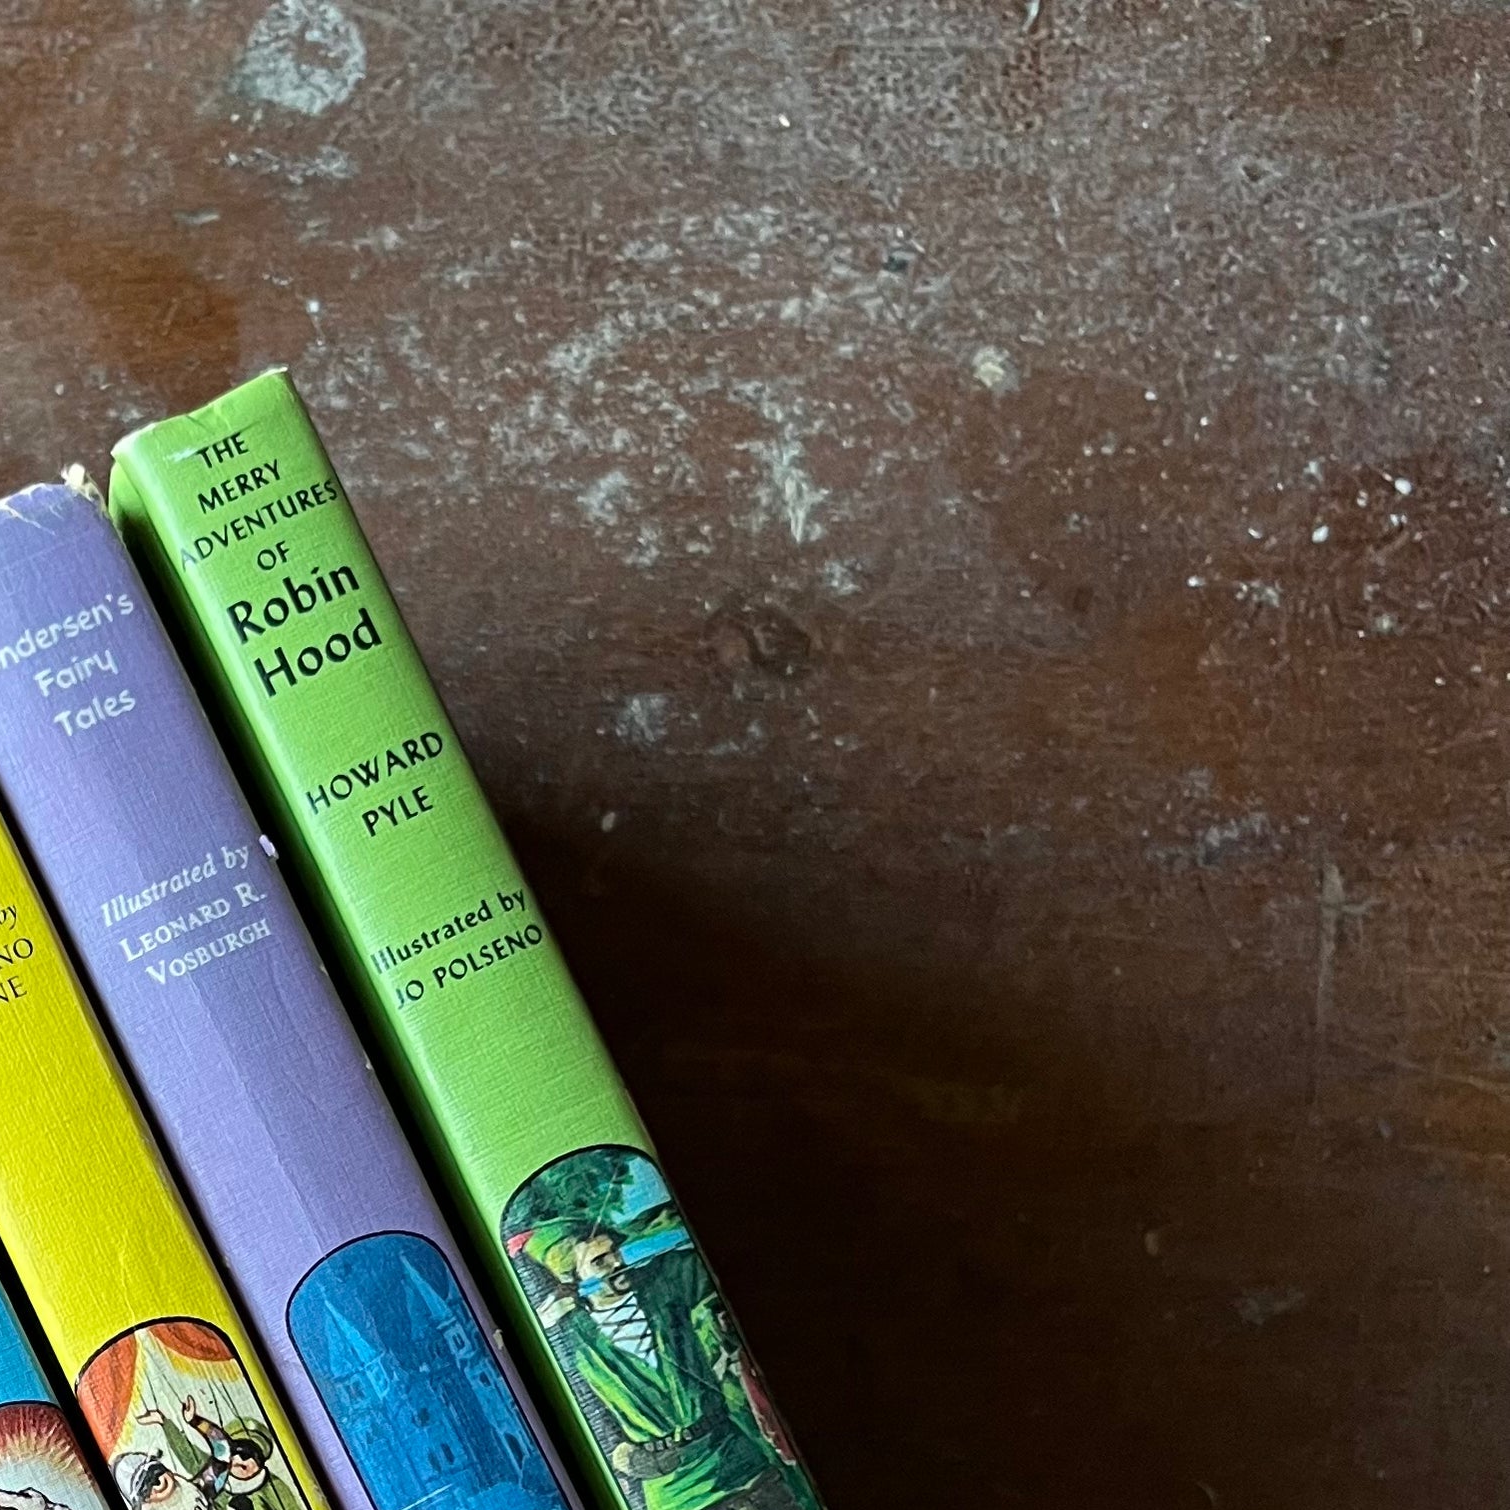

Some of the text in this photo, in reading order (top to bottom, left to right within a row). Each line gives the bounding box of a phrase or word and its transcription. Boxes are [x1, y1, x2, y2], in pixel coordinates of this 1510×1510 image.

[196, 431, 249, 469] THE
[197, 458, 281, 514] MERRY
[180, 478, 338, 572] ADVENTURES
[257, 540, 290, 571] OF
[226, 565, 360, 645] Robin
[34, 649, 119, 697] Fairy
[254, 607, 382, 697] Hood
[54, 689, 136, 736] Tales
[306, 731, 443, 815] HOWARD
[362, 785, 433, 837] PYLE
[99, 845, 249, 927] Illustrated by
[235, 881, 267, 908] R.
[370, 889, 525, 974] Illustrated by
[395, 924, 543, 1009] JO POLSENO
